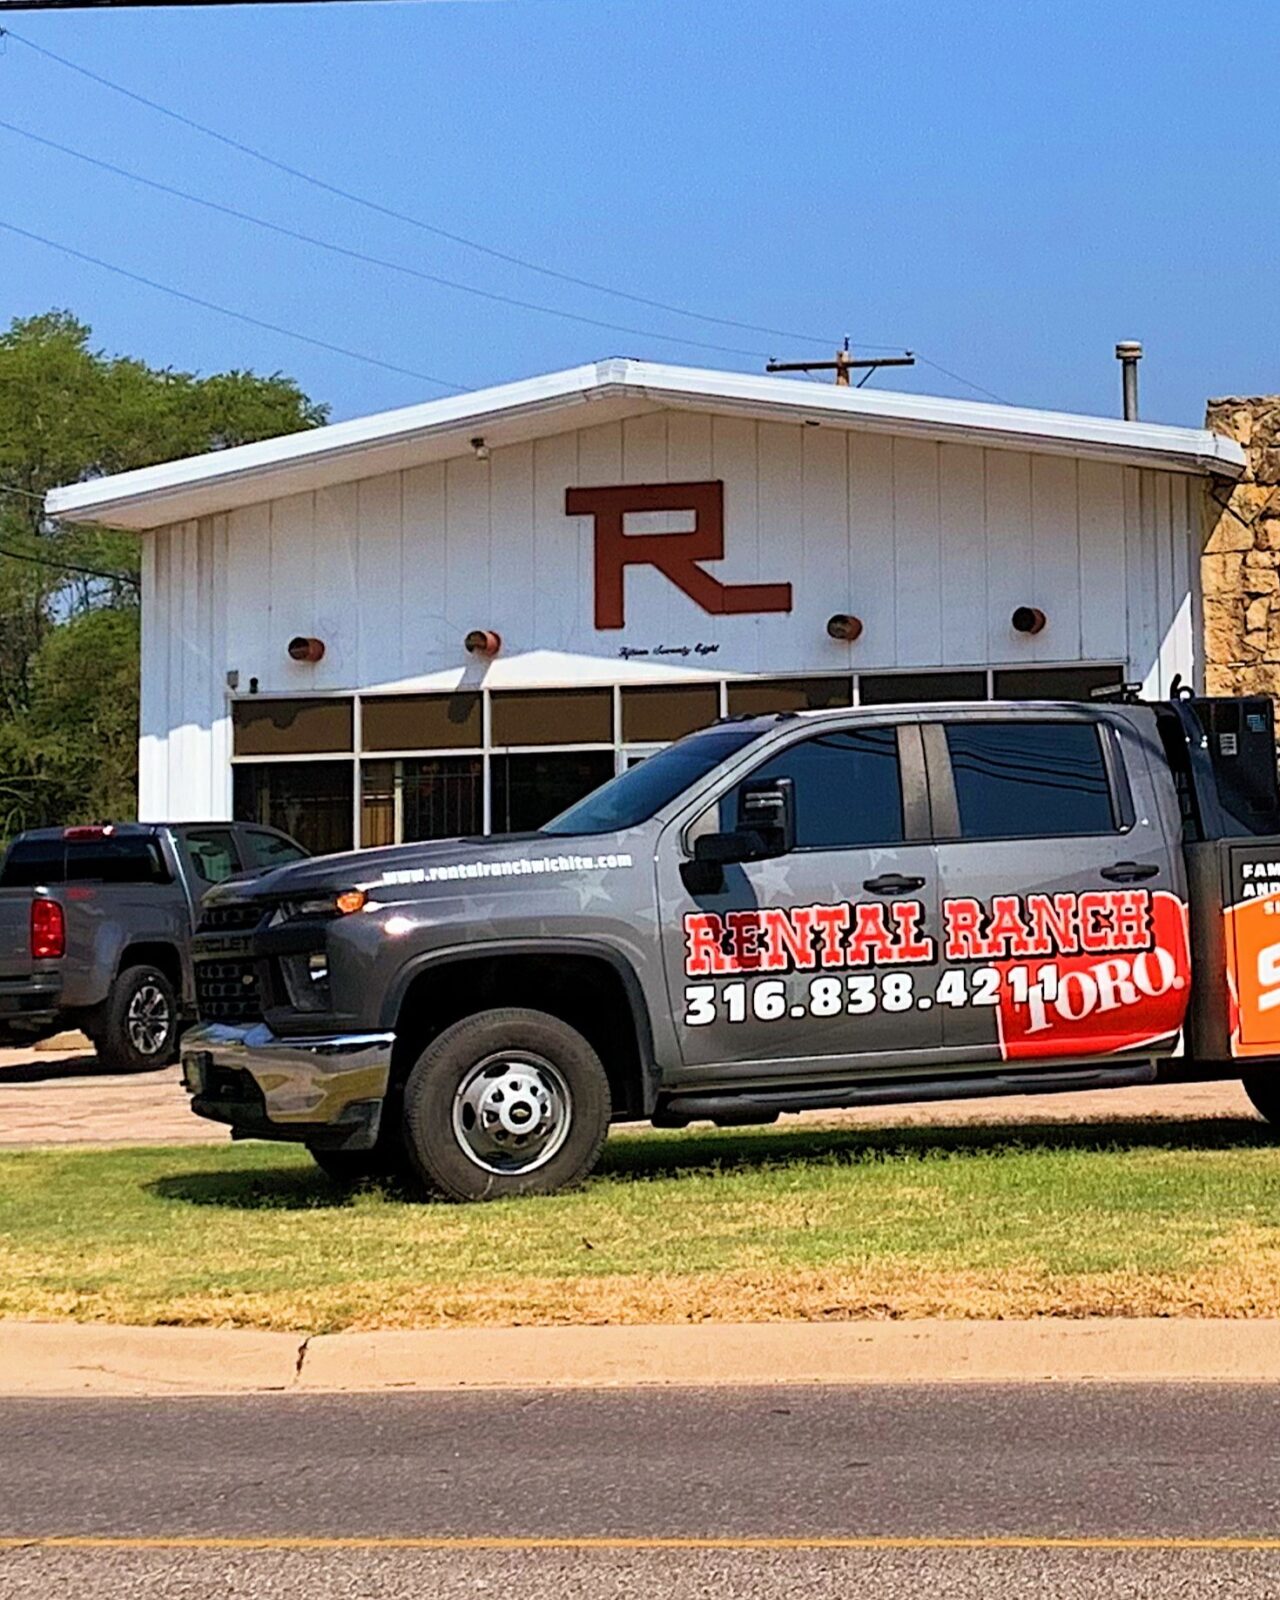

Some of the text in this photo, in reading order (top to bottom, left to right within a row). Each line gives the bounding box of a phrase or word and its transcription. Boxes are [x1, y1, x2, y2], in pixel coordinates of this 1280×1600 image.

[684, 890, 1151, 976] RENTAL RANCH
[684, 964, 1059, 1026] 316.838.4211
